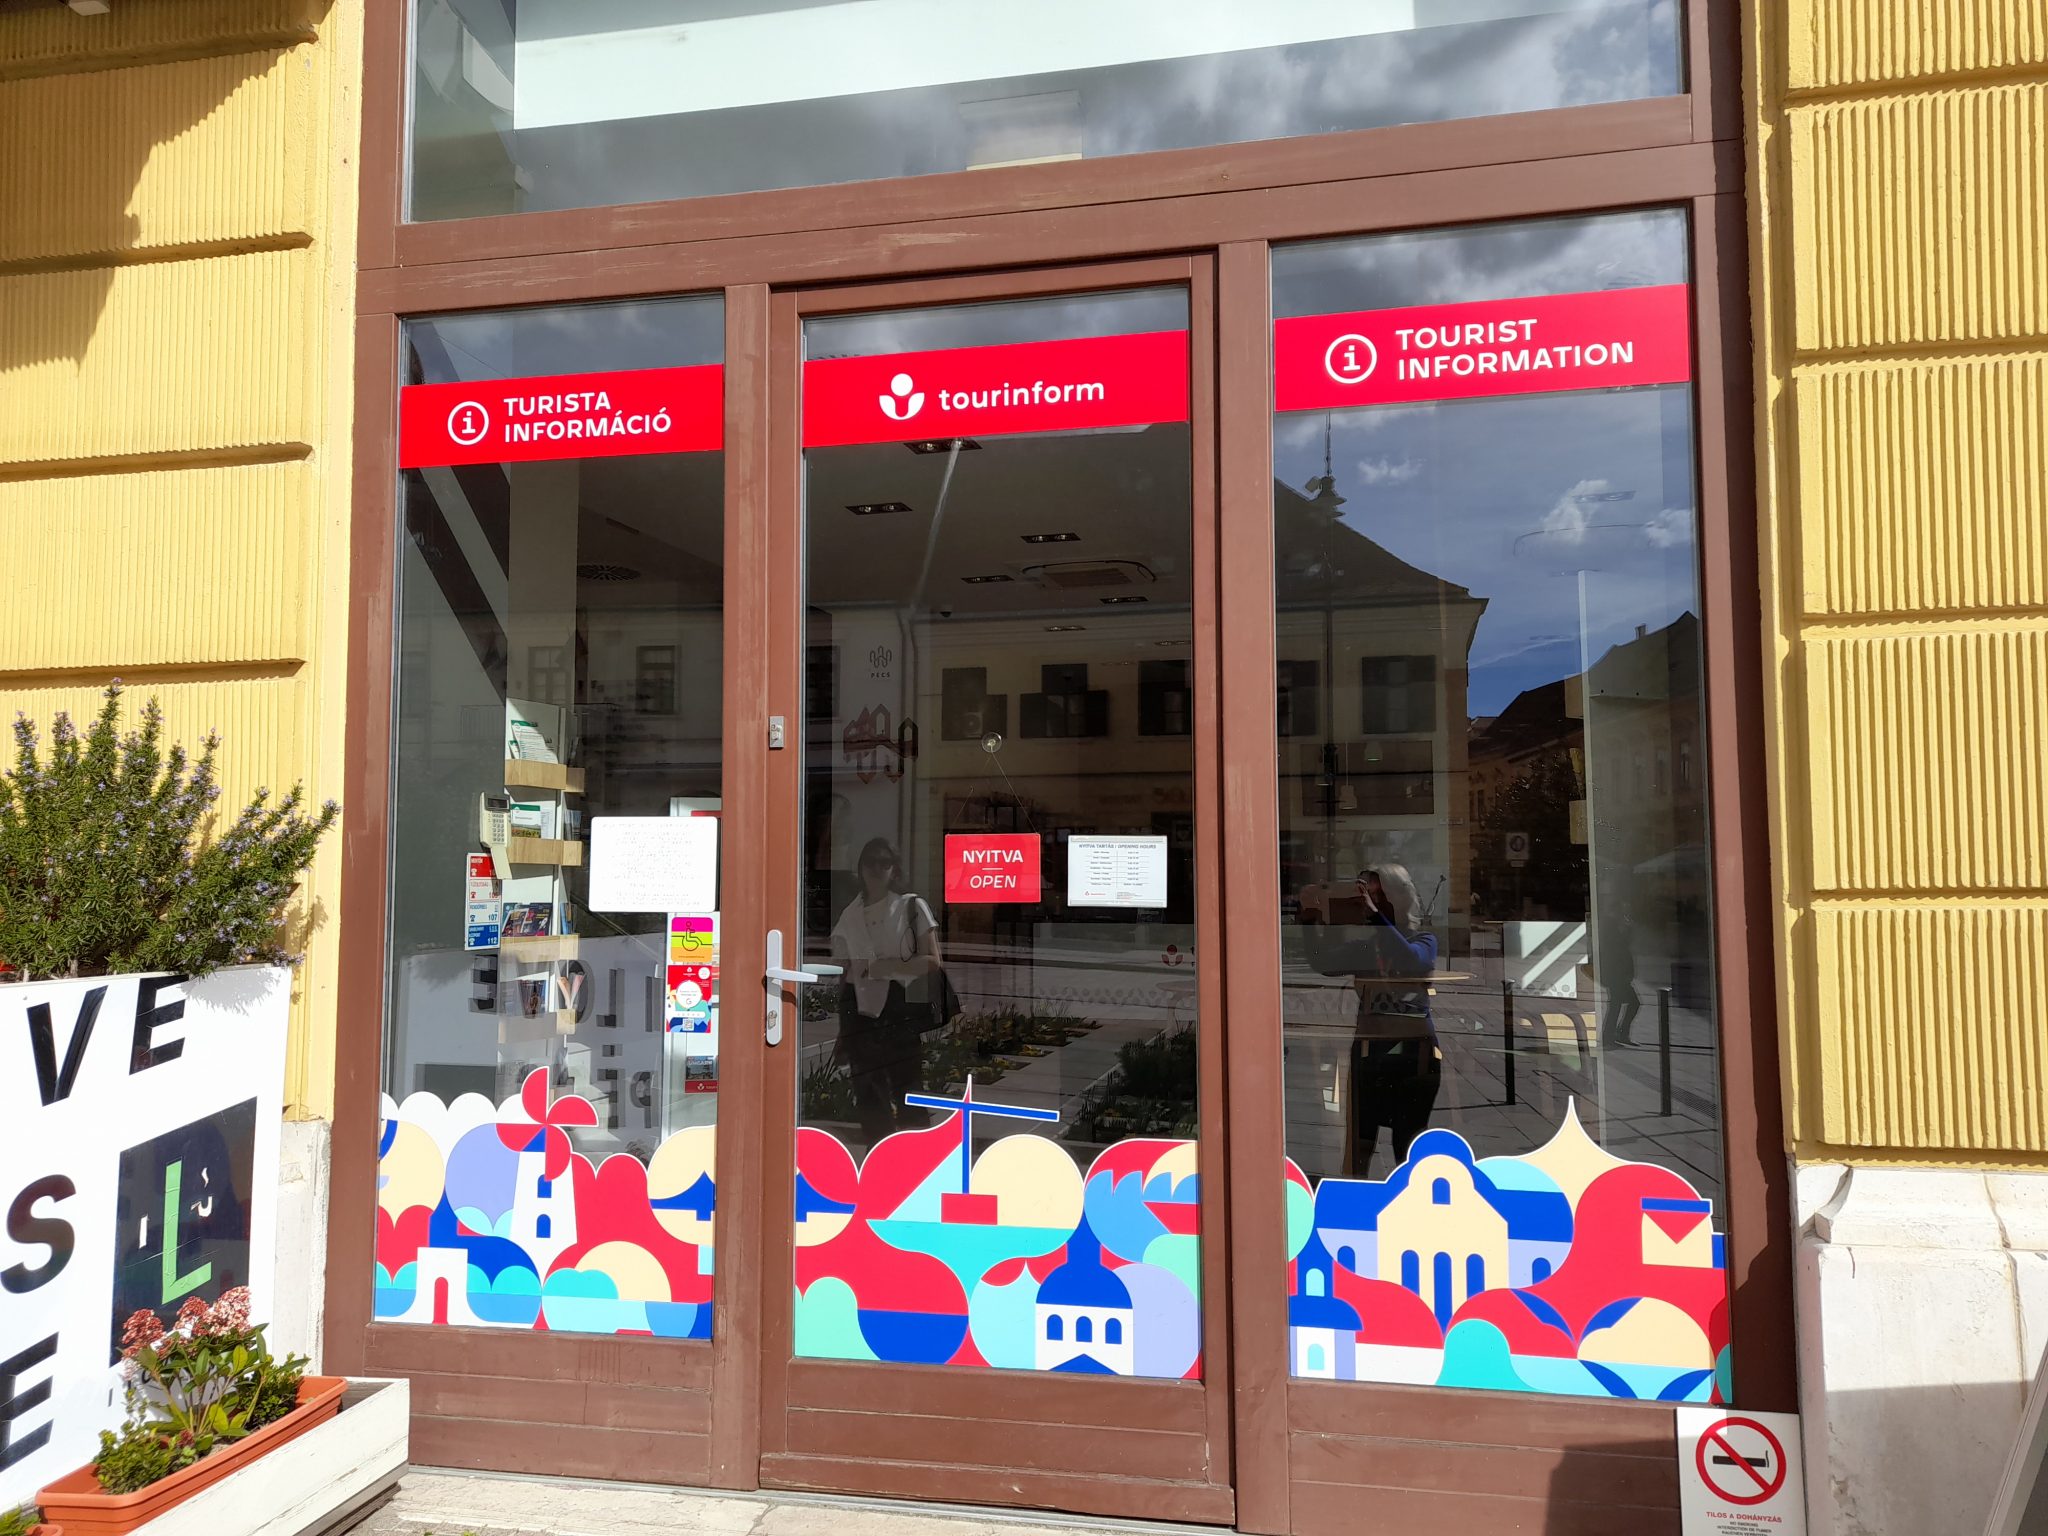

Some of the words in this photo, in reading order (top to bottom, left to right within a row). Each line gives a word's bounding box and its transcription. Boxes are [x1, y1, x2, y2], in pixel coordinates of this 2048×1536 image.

[1396, 318, 1538, 351] TOURIST
[1398, 341, 1634, 381] INFORMATION
[503, 391, 611, 417] TURISTA
[938, 380, 1105, 411] tourinform
[505, 406, 672, 443] INFORMÁCIÓ
[962, 849, 1024, 864] NYITVA
[969, 874, 1017, 889] OPEN
[488, 913, 498, 921] 107
[487, 936, 498, 945] 112
[1706, 1511, 1728, 1519] TILOS
[1736, 1513, 1783, 1523] DOHÁNYZÁS
